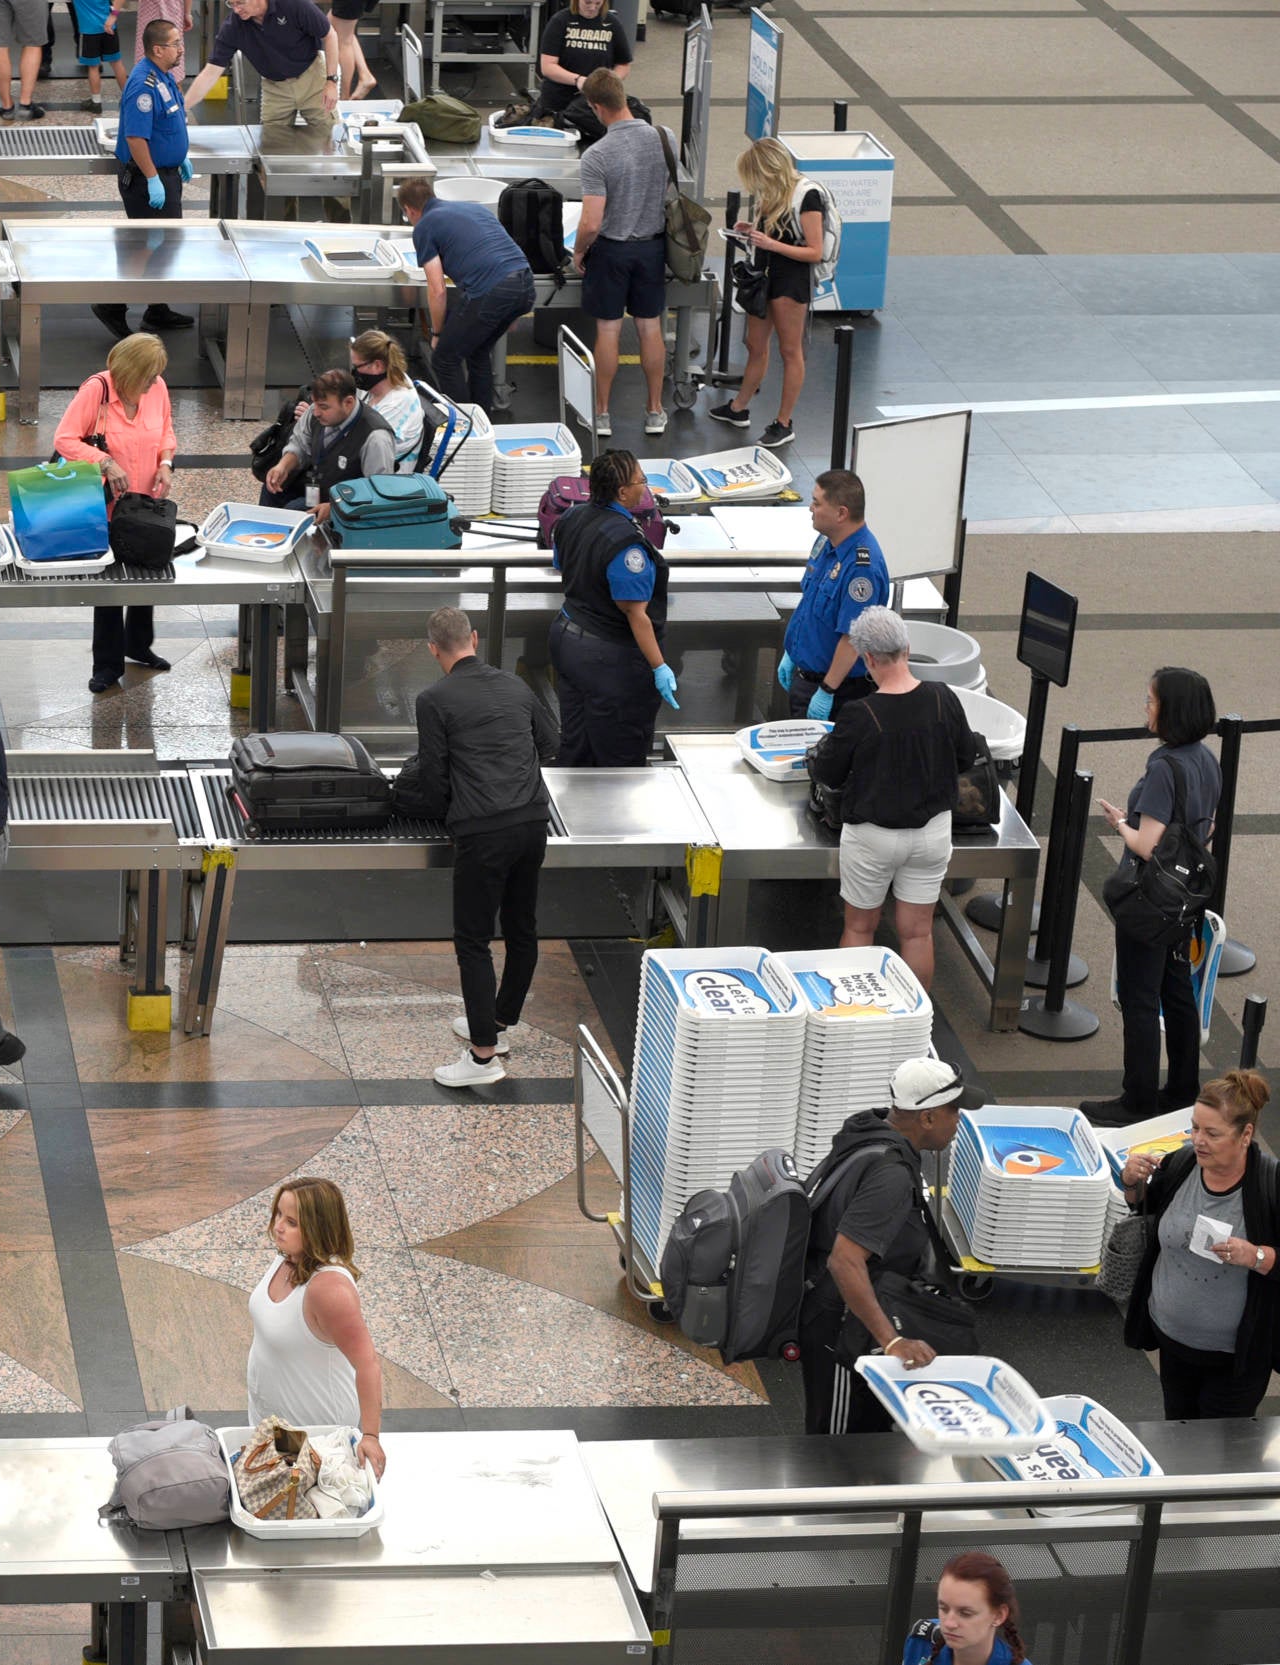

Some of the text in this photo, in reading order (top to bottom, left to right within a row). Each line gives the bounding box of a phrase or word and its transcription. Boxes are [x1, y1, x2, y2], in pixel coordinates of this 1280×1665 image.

[565, 27, 613, 42] COLORADO
[566, 40, 607, 51] FOOTBALL
[849, 178, 879, 187] WATER
[839, 976, 862, 997] idea?
[851, 974, 874, 997] bright
[863, 972, 887, 992] Need
[726, 984, 749, 1004] Let's
[917, 1621, 932, 1636] TSA
